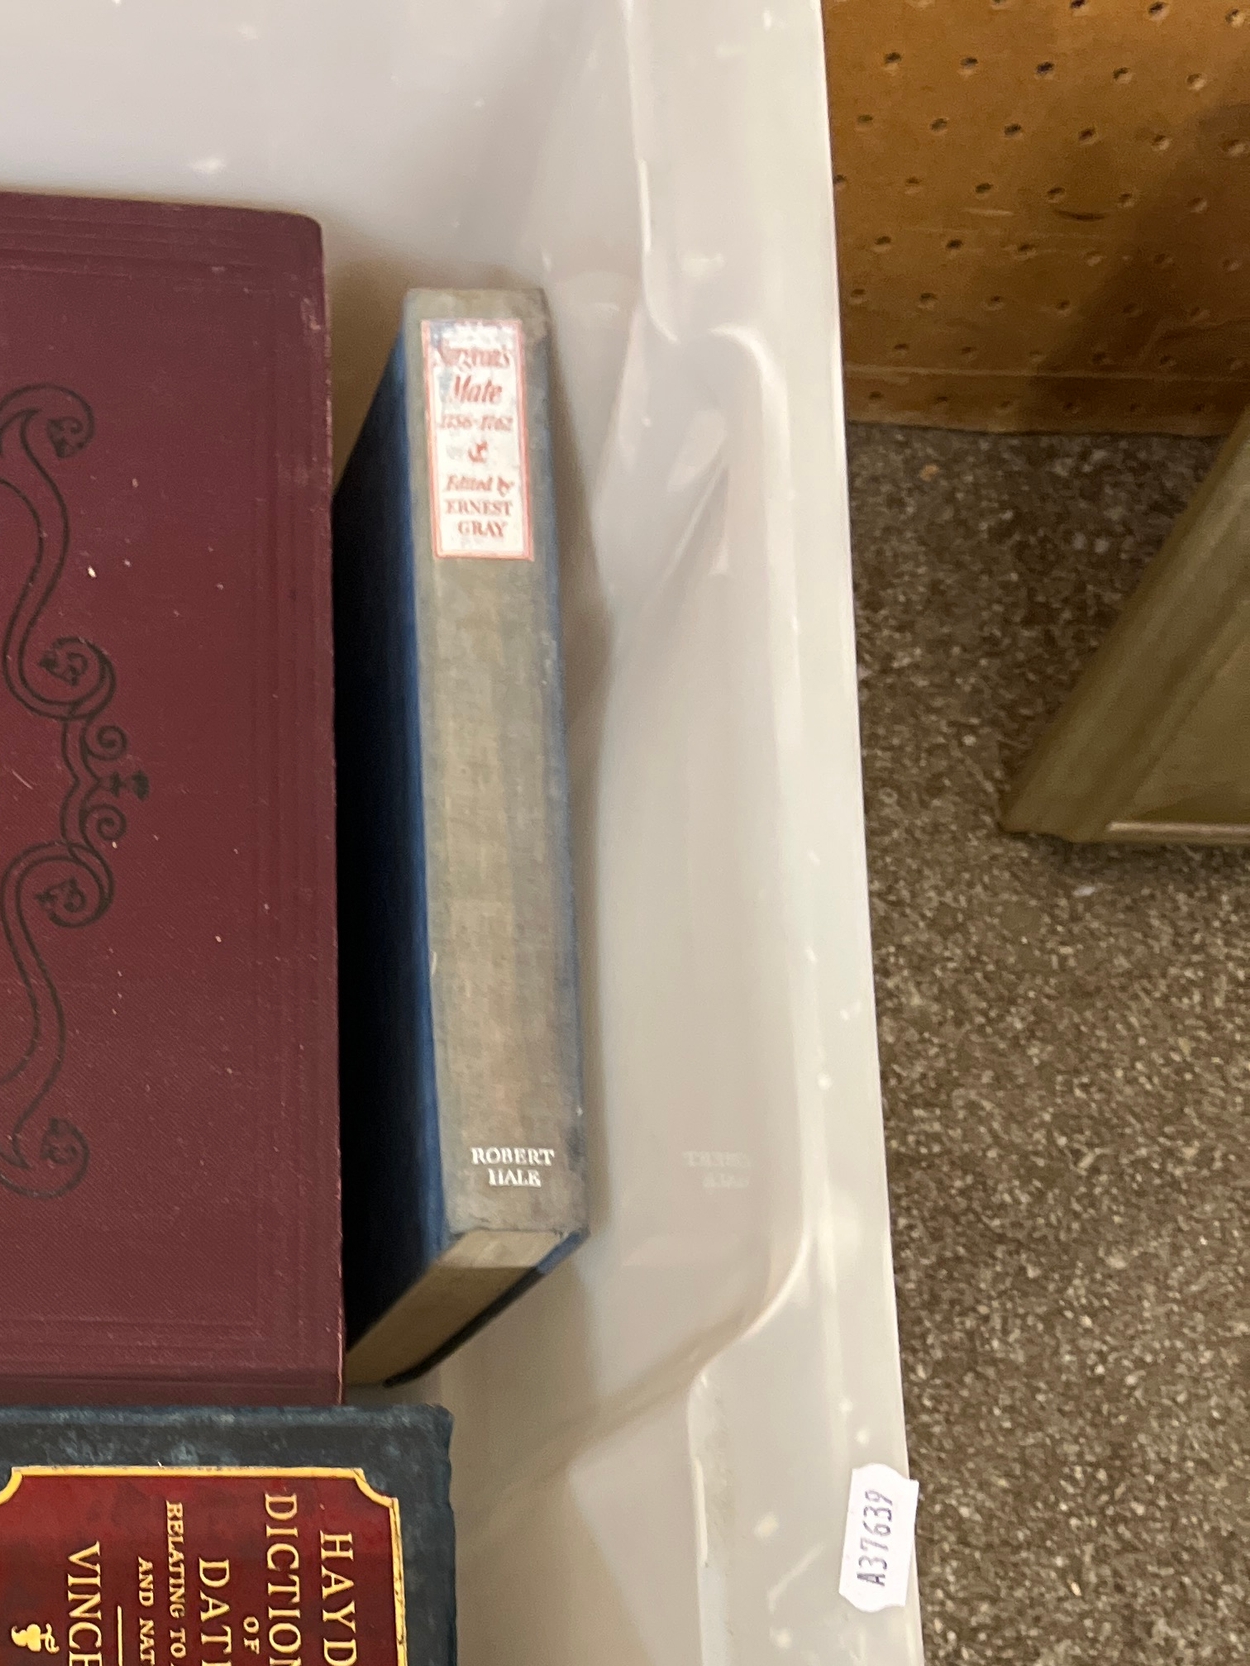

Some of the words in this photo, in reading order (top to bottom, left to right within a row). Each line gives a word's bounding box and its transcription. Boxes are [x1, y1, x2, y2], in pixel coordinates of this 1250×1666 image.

[451, 374, 503, 404] Mate
[444, 499, 513, 517] ERNEST
[457, 520, 509, 538] GRAY
[470, 1147, 555, 1167] ROBERT
[487, 1167, 541, 1188] HALE
[856, 1488, 894, 1588] A37639
[165, 1500, 187, 1619] RELATING
[137, 1555, 156, 1608] AND
[167, 1628, 188, 1661] TO
[242, 1615, 261, 1655] OF
